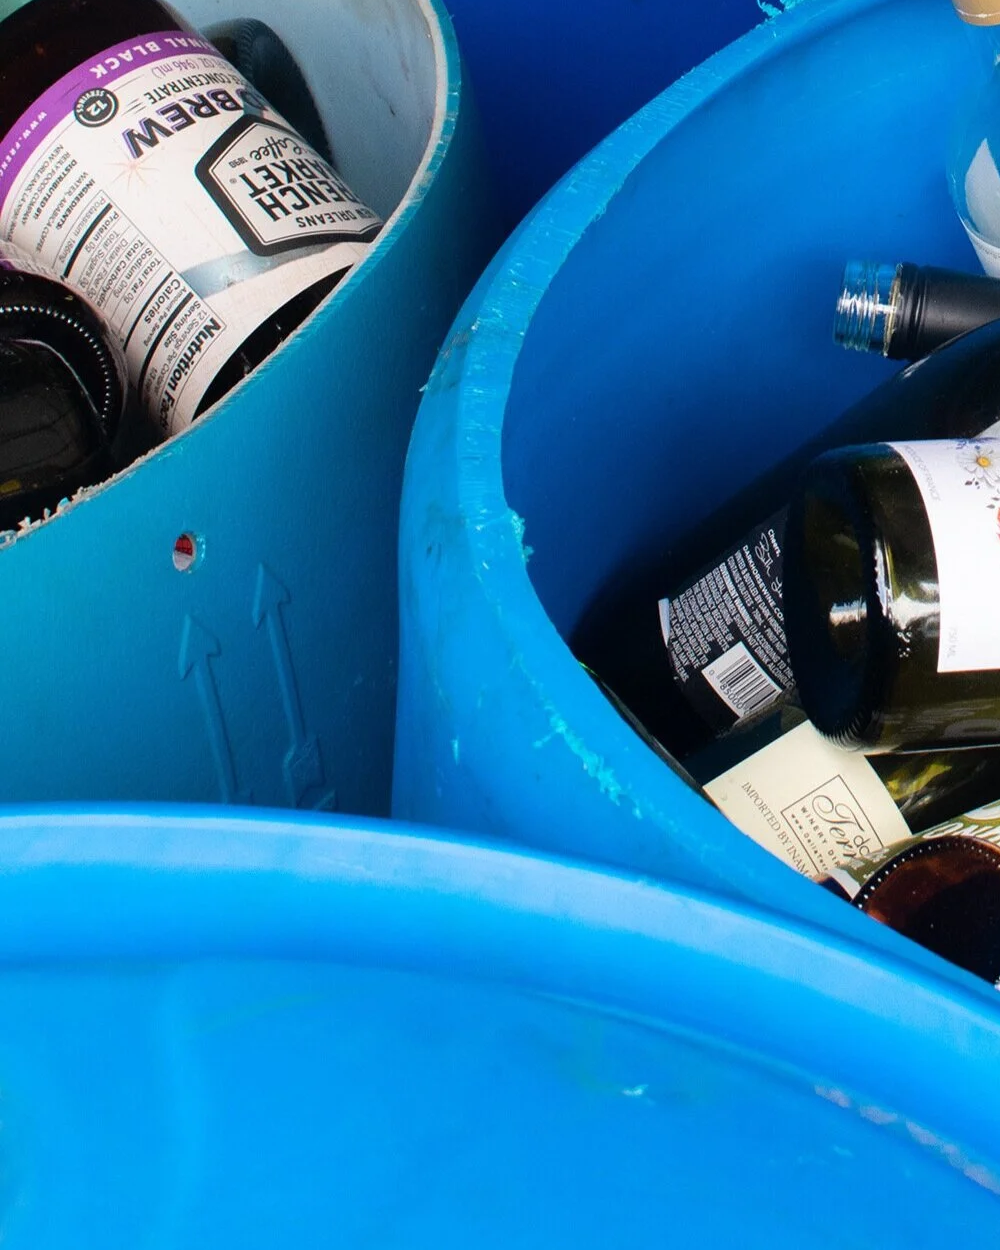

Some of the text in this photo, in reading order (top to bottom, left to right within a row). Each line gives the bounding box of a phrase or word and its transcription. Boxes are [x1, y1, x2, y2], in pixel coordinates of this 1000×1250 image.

[88, 39, 158, 79] BLACK
[144, 72, 230, 104] CONCENTRATE
[85, 96, 108, 117] 12
[121, 88, 242, 159] BREW
[48, 143, 62, 163] NEW
[54, 151, 70, 172] REILY
[249, 135, 304, 160] Coffee
[36, 168, 56, 194] FOODS
[38, 158, 77, 209] DISTRIBUTED
[64, 170, 88, 198] WATER,
[45, 197, 66, 227] ARABICA
[56, 178, 95, 230] INGREDIENTS:
[72, 196, 106, 237] Potassium
[295, 209, 356, 227] ORLEANS
[92, 211, 119, 241] Protein
[101, 230, 118, 249] Total
[85, 249, 104, 277] Sugars
[105, 238, 127, 266] Dietary
[124, 238, 143, 260] Total
[92, 266, 107, 288] Fiber
[112, 246, 152, 298] Sodium 0mg
[122, 257, 160, 304] Total Fat 0g
[143, 276, 181, 326] Calories
[196, 308, 207, 319] 12
[143, 287, 187, 346] Amount Per Serving
[163, 300, 201, 348] Serving Size
[173, 318, 198, 349] Servings
[166, 317, 221, 392] Nutrition
[166, 350, 176, 363] Per
[767, 529, 780, 556] Cheers,
[692, 583, 701, 596] THE
[726, 555, 741, 583] CONTAINS
[736, 581, 754, 607] SULFITES
[695, 594, 705, 606] RISK
[698, 578, 734, 642] PREGNANCY BECAUSE OF
[700, 604, 708, 613] OF
[704, 573, 733, 625] BEVERAGES DURING
[742, 573, 758, 596] BOTTLED
[754, 595, 762, 604] BY
[758, 602, 771, 617] DARK
[767, 615, 783, 635] HORSE
[673, 623, 683, 636] CAR
[678, 592, 711, 654] ALCOHOLIC BEVERAGES
[687, 595, 715, 643] CONSUMPTION OF
[703, 611, 716, 628] BIRTH
[718, 562, 738, 598] GOVERNMENT
[754, 631, 780, 663] ACCORDING
[776, 660, 785, 670] TO
[721, 591, 738, 616] WOMEN
[733, 614, 750, 637] SHOULD
[746, 634, 759, 649] NOT
[754, 646, 770, 664] DRINK
[671, 640, 682, 654] AND
[678, 634, 687, 644] OR
[680, 619, 693, 636] YOUR
[688, 634, 704, 657] ABILITY
[699, 654, 708, 664] TO
[682, 642, 700, 669] OPERATE
[741, 781, 791, 846] IMPORTED BY
[800, 805, 827, 845] WINERY
